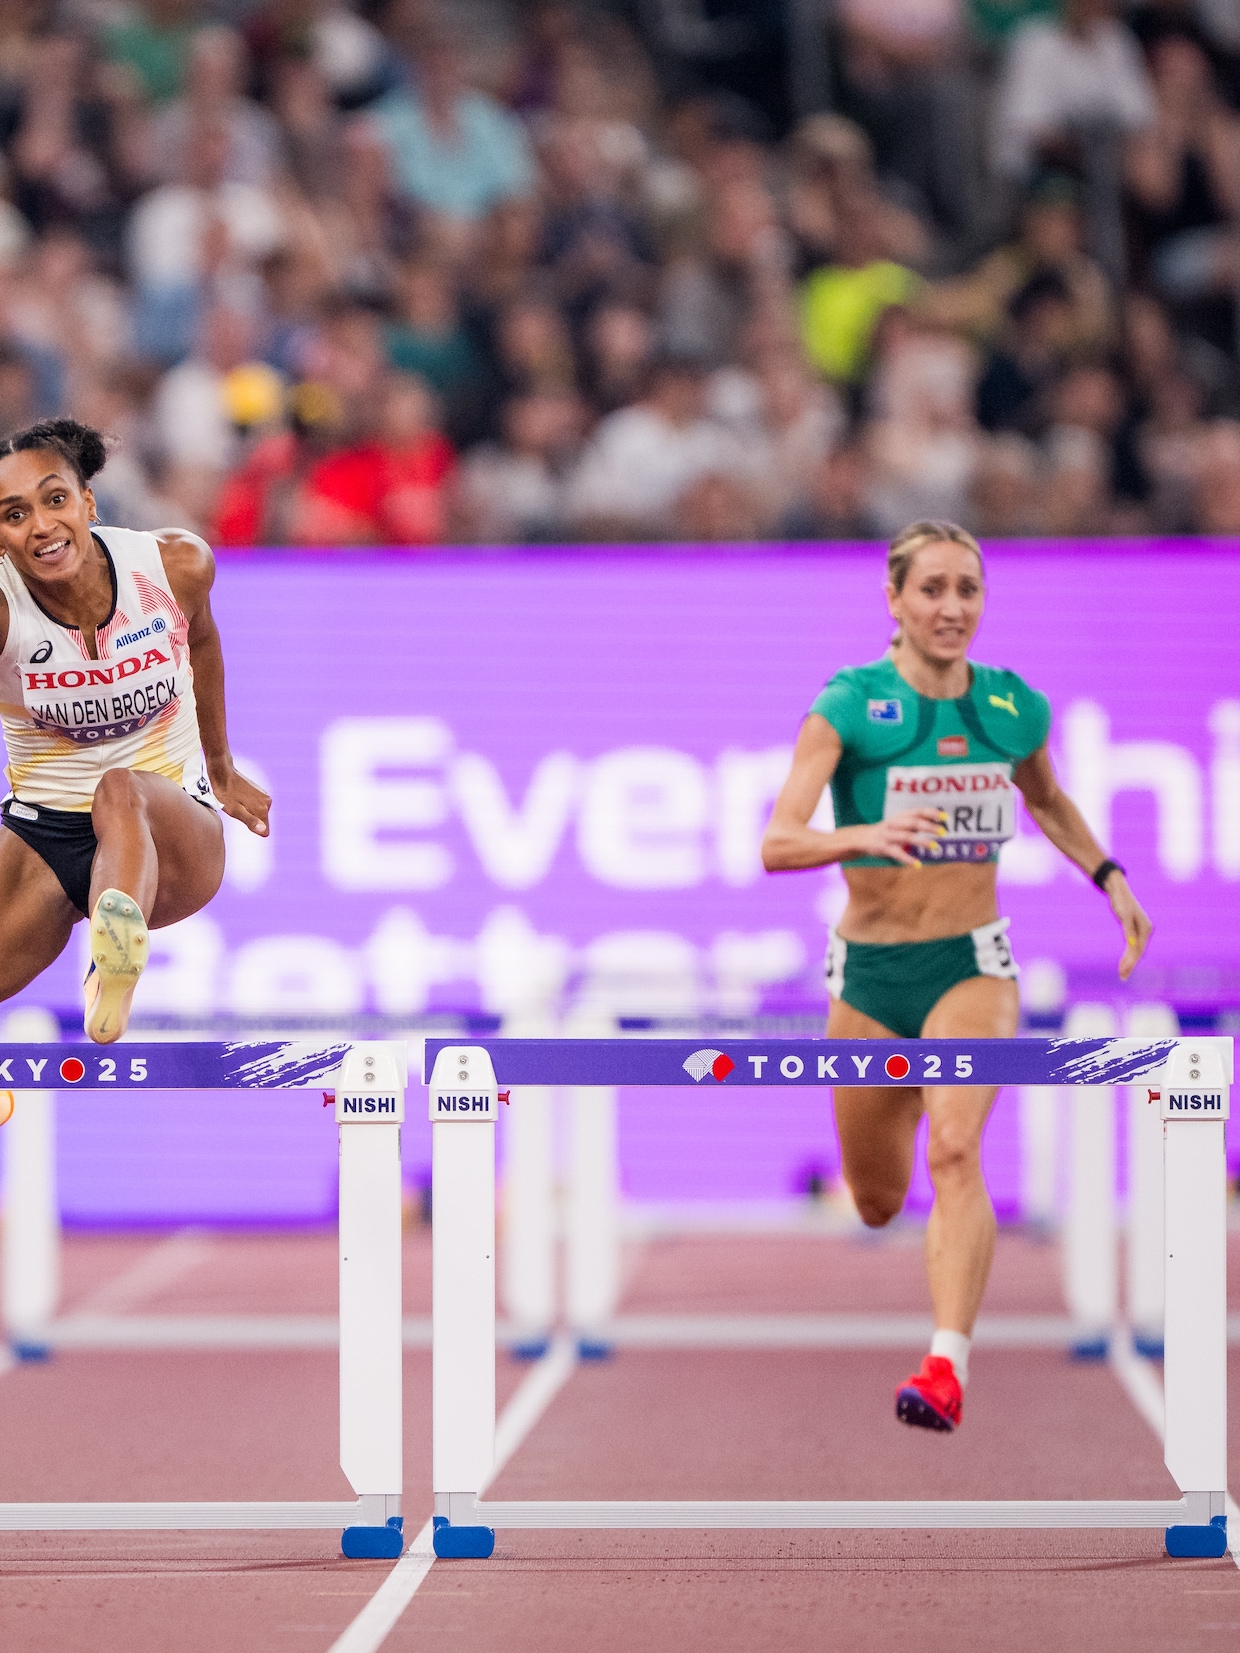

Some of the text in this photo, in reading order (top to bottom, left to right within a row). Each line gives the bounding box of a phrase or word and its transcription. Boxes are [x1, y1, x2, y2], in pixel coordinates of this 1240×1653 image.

[116, 627, 151, 649] Allianz
[25, 648, 171, 690] HONDA
[31, 676, 179, 726] VAN DEN BROECK
[893, 773, 1010, 795] HONDA
[343, 1097, 396, 1114] NISHI
[437, 1096, 490, 1112] NISHI
[1169, 1094, 1222, 1110] NISHI
